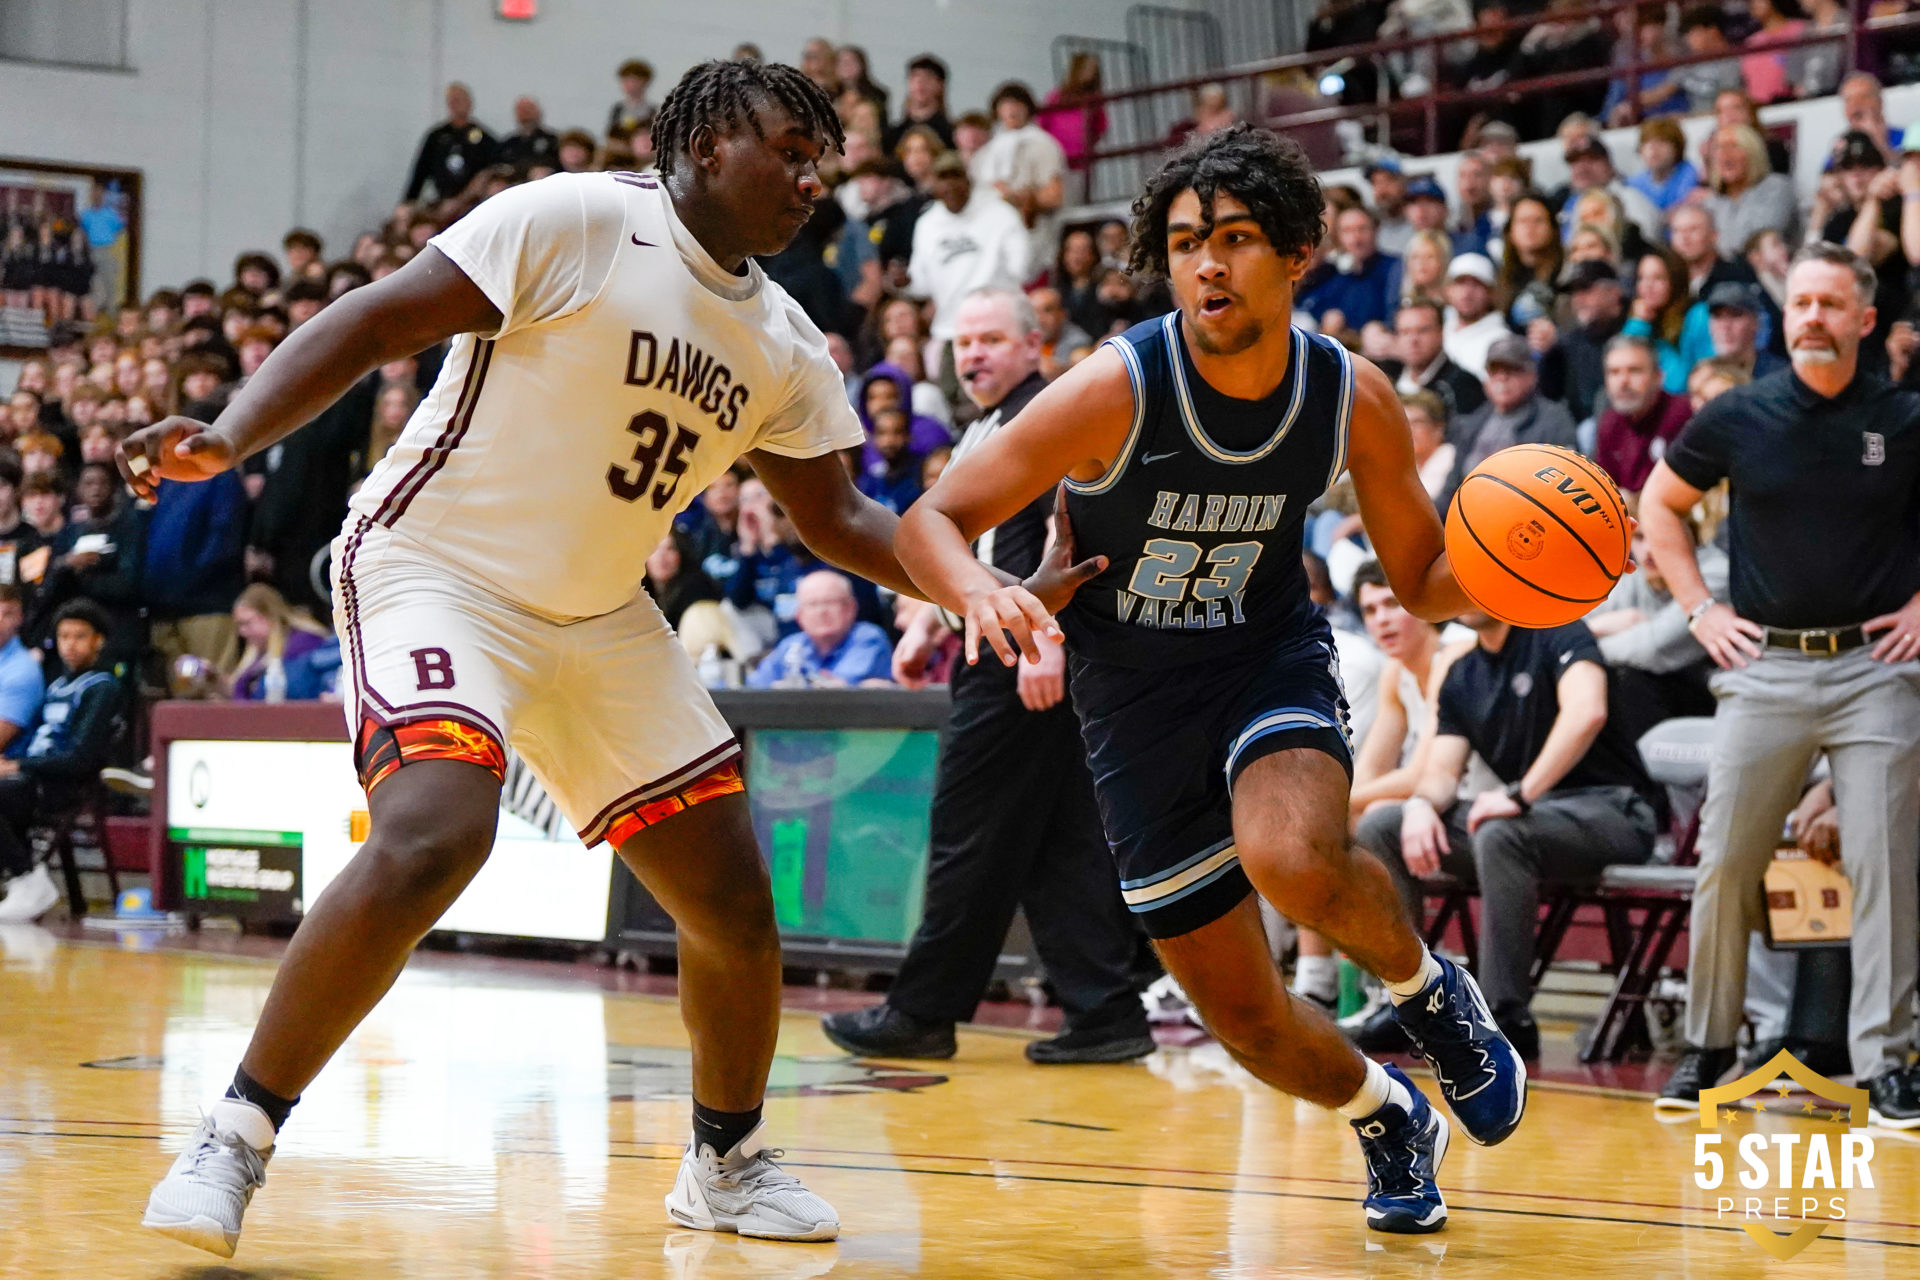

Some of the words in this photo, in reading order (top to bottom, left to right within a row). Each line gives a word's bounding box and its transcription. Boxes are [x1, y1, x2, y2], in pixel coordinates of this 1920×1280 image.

[624, 329, 750, 432] DAWGS
[605, 408, 701, 511] 35
[1862, 431, 1885, 466] B
[1147, 490, 1287, 532] HARDIN
[1534, 466, 1602, 515] EVO
[1599, 511, 1615, 529] NXT
[1128, 538, 1264, 601] 23
[1116, 589, 1246, 629] VALLEY
[410, 647, 456, 691] B
